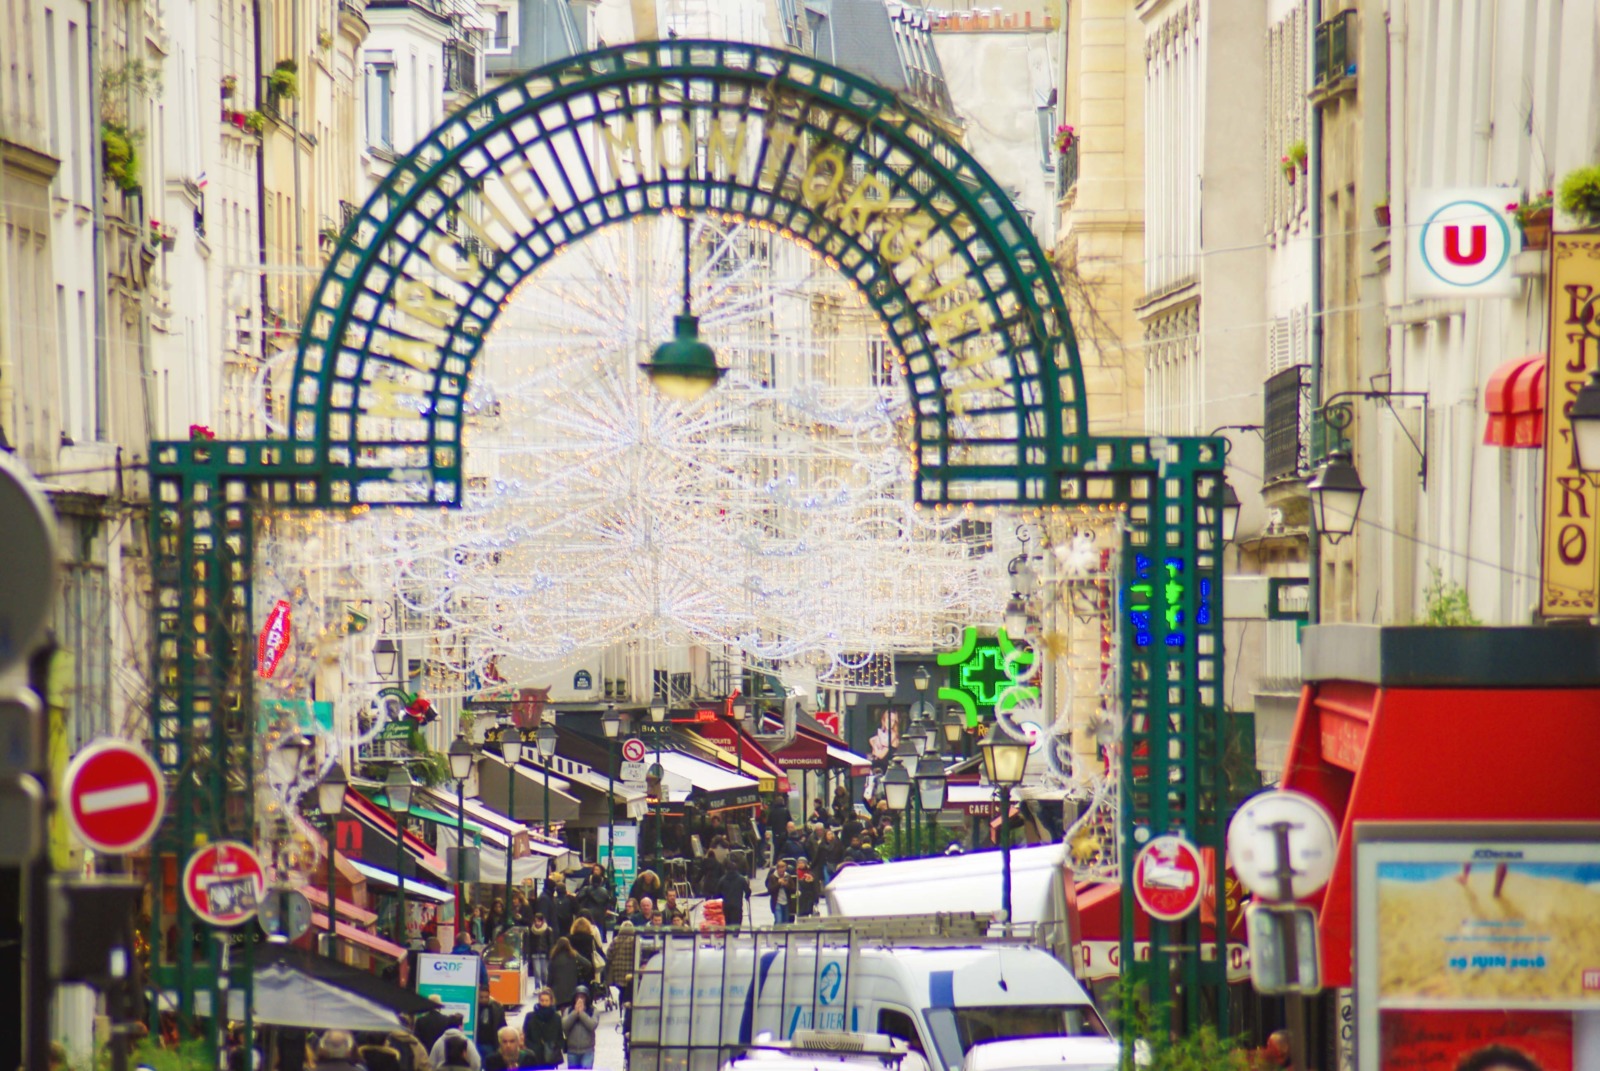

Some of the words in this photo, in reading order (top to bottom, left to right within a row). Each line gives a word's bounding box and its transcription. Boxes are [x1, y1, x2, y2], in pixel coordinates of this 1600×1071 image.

[1443, 225, 1487, 266] U
[594, 118, 1006, 416] MONTORGUEIL
[800, 1010, 844, 1030] ATLIER
